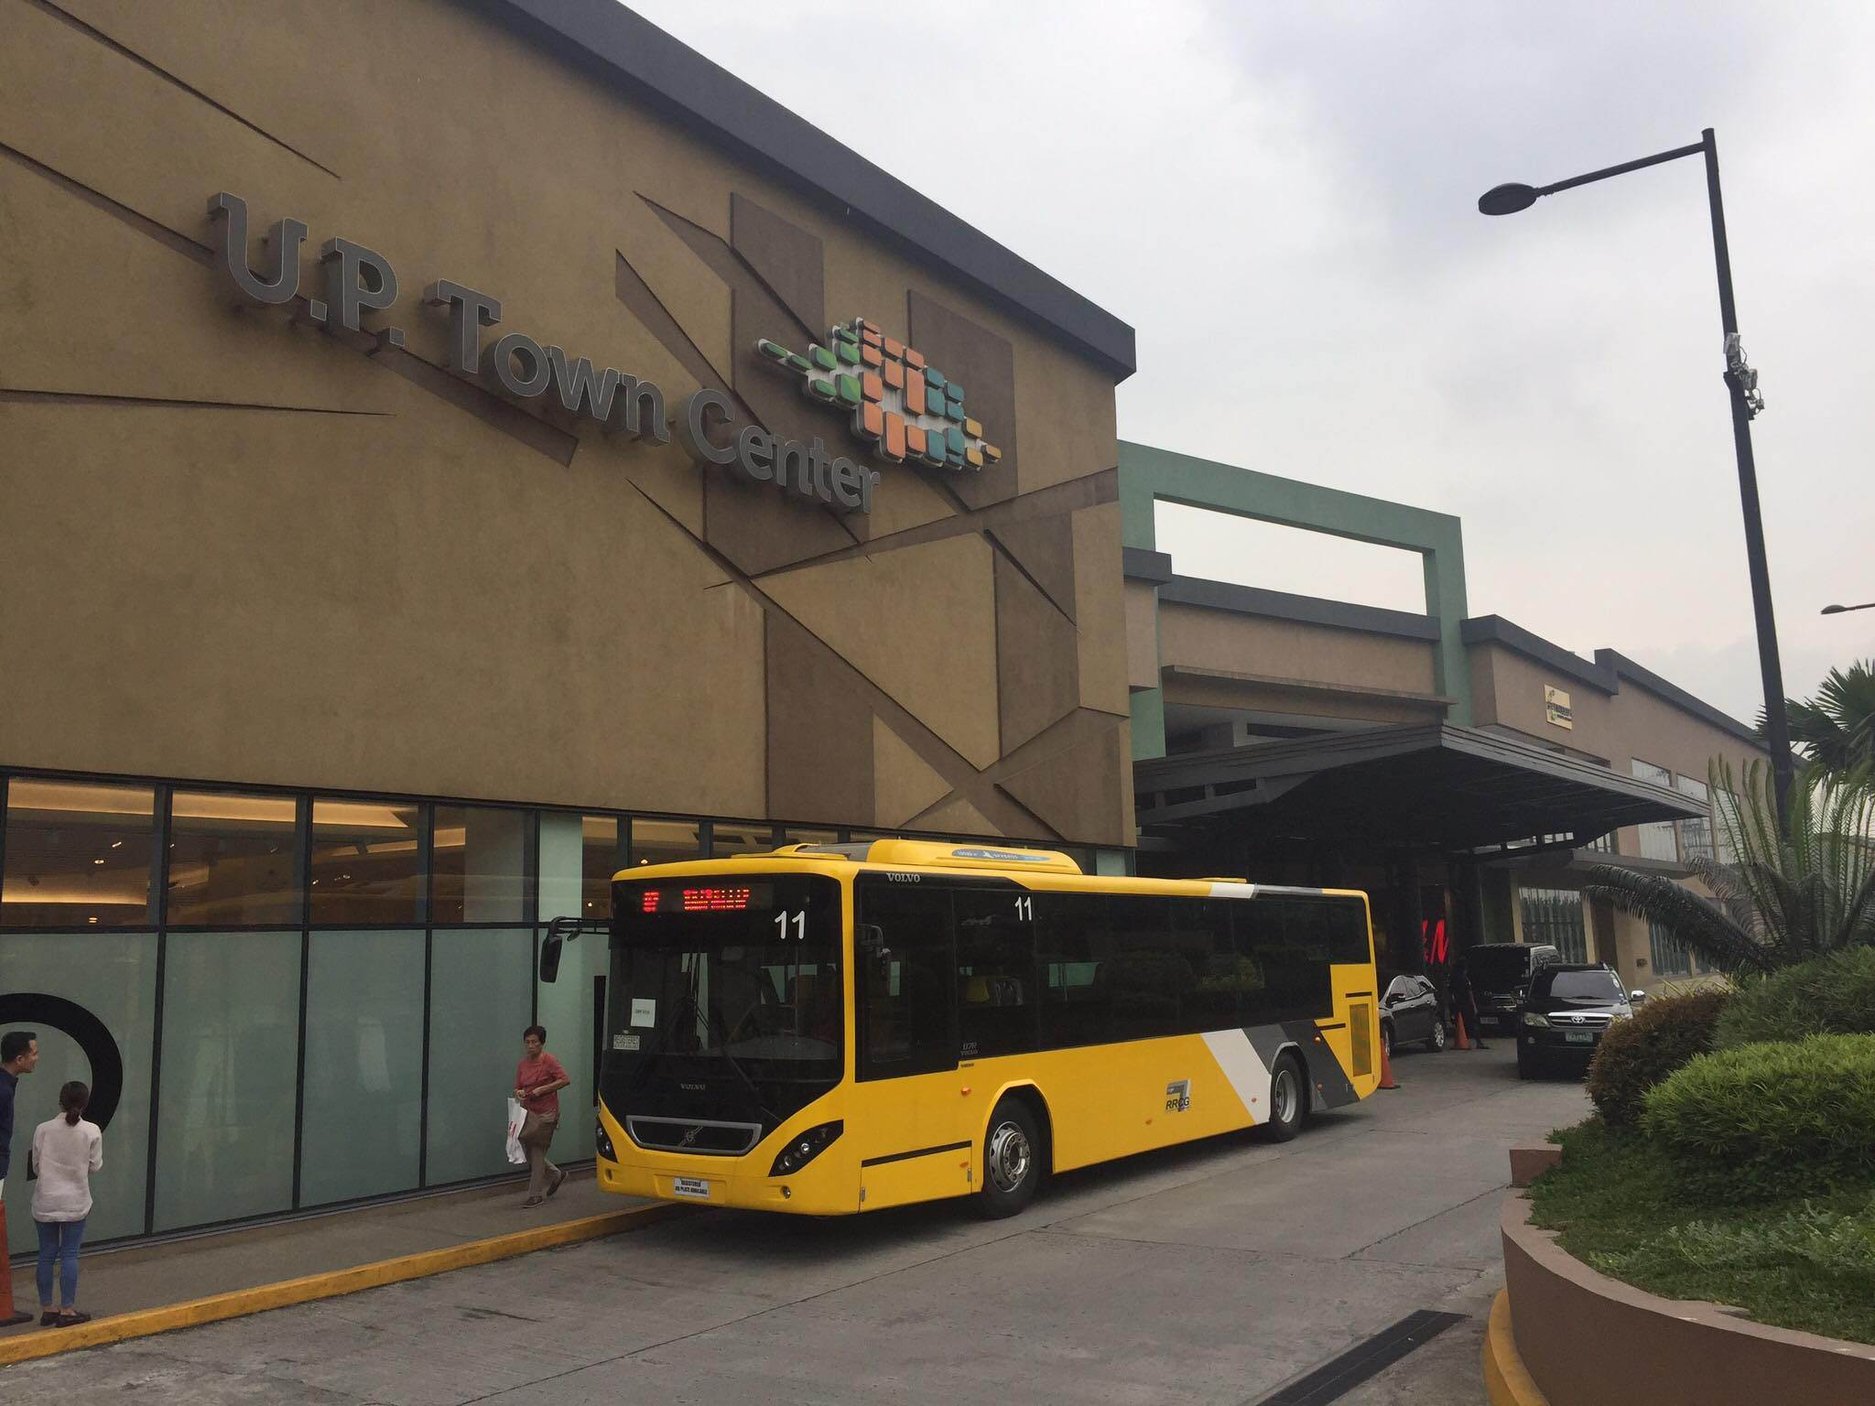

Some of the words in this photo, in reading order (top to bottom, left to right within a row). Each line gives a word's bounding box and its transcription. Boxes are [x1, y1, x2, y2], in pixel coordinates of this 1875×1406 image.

[211, 190, 406, 348] U.P.
[436, 277, 671, 445] Town
[687, 387, 881, 514] Center
[886, 872, 921, 883] VOLVO
[1014, 896, 1032, 921] 11
[774, 910, 806, 940] 11
[1165, 1096, 1190, 1111] RRCG
